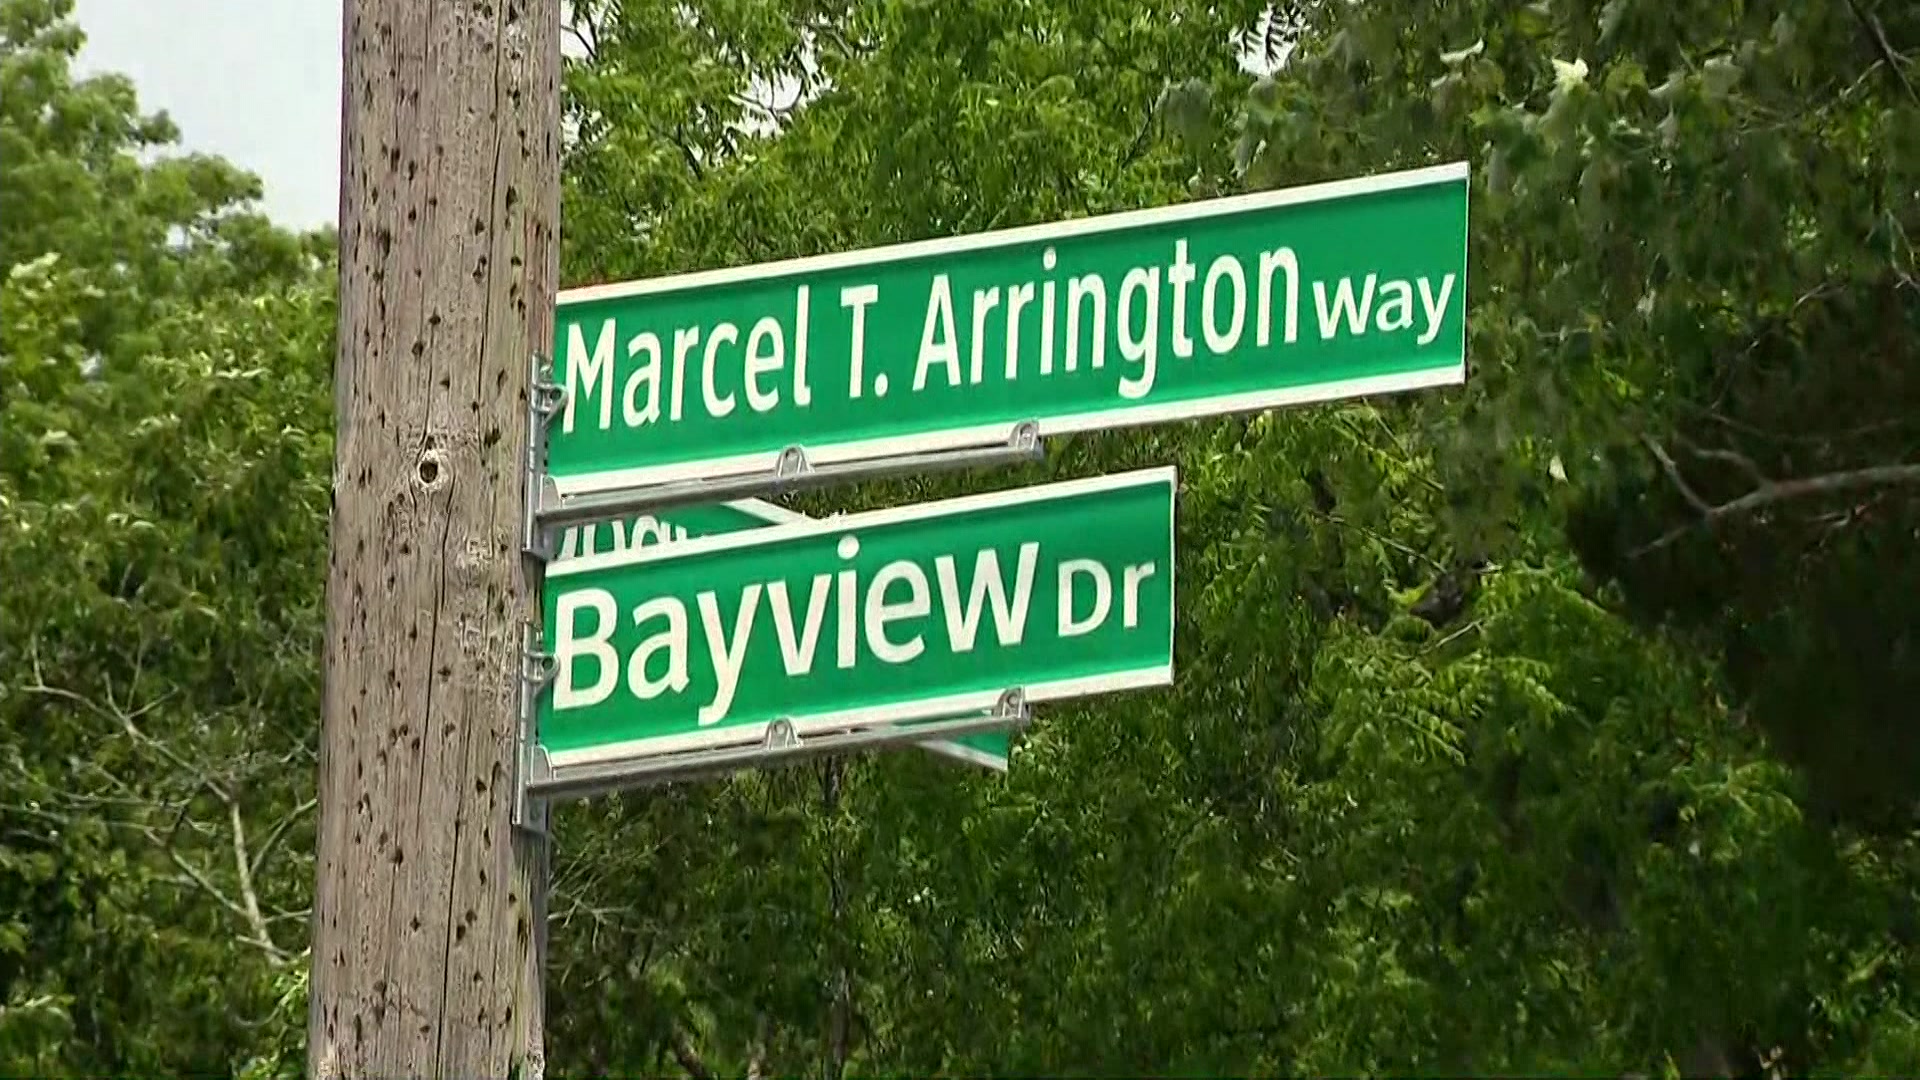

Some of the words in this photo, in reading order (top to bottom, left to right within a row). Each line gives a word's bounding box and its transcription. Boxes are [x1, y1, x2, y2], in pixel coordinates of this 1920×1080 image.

[562, 285, 812, 434] Marcel
[841, 284, 889, 398] T.
[912, 246, 1300, 399] Arrington
[1312, 272, 1457, 346] Way
[552, 536, 1040, 726] Bayview
[1058, 559, 1156, 638] Dr
